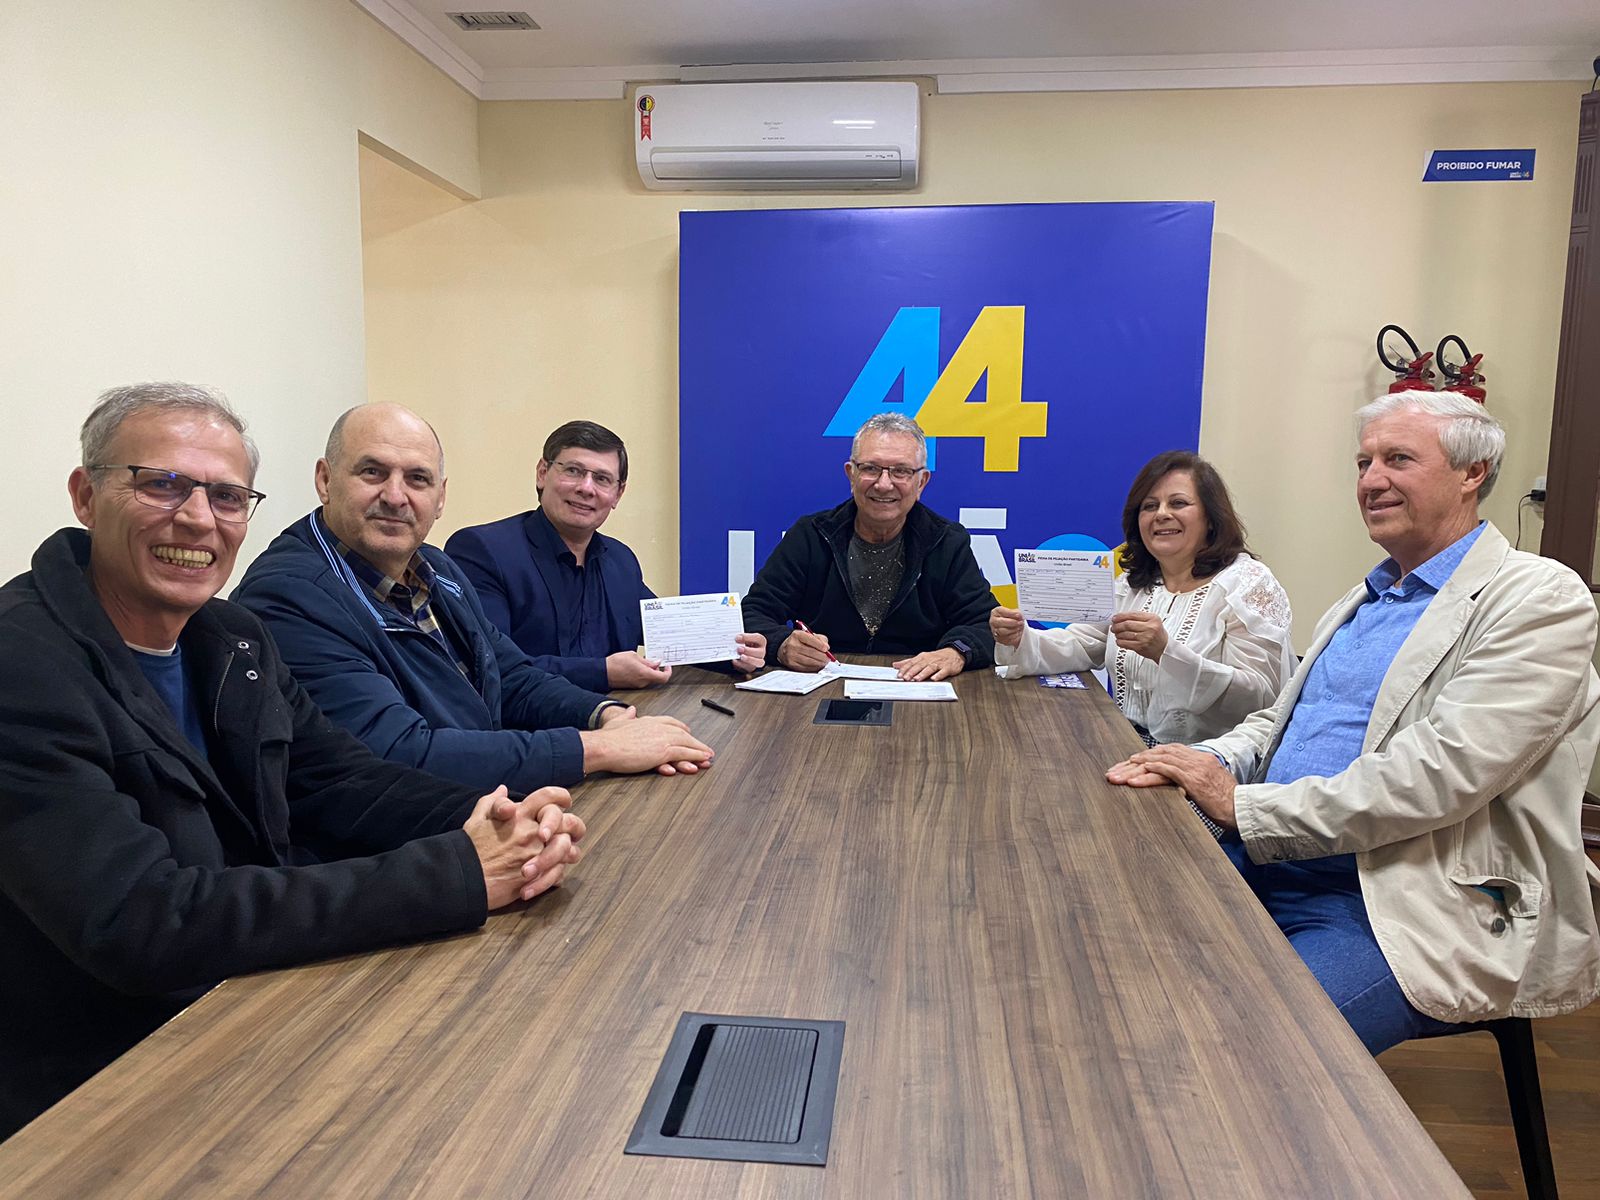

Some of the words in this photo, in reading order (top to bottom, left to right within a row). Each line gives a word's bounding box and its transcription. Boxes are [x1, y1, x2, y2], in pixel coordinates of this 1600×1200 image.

[1436, 161, 1484, 171] PROIBIDO
[1486, 161, 1522, 170] FUMAR
[822, 305, 1049, 473] 44
[1093, 555, 1110, 569] 44
[720, 595, 737, 607] 44
